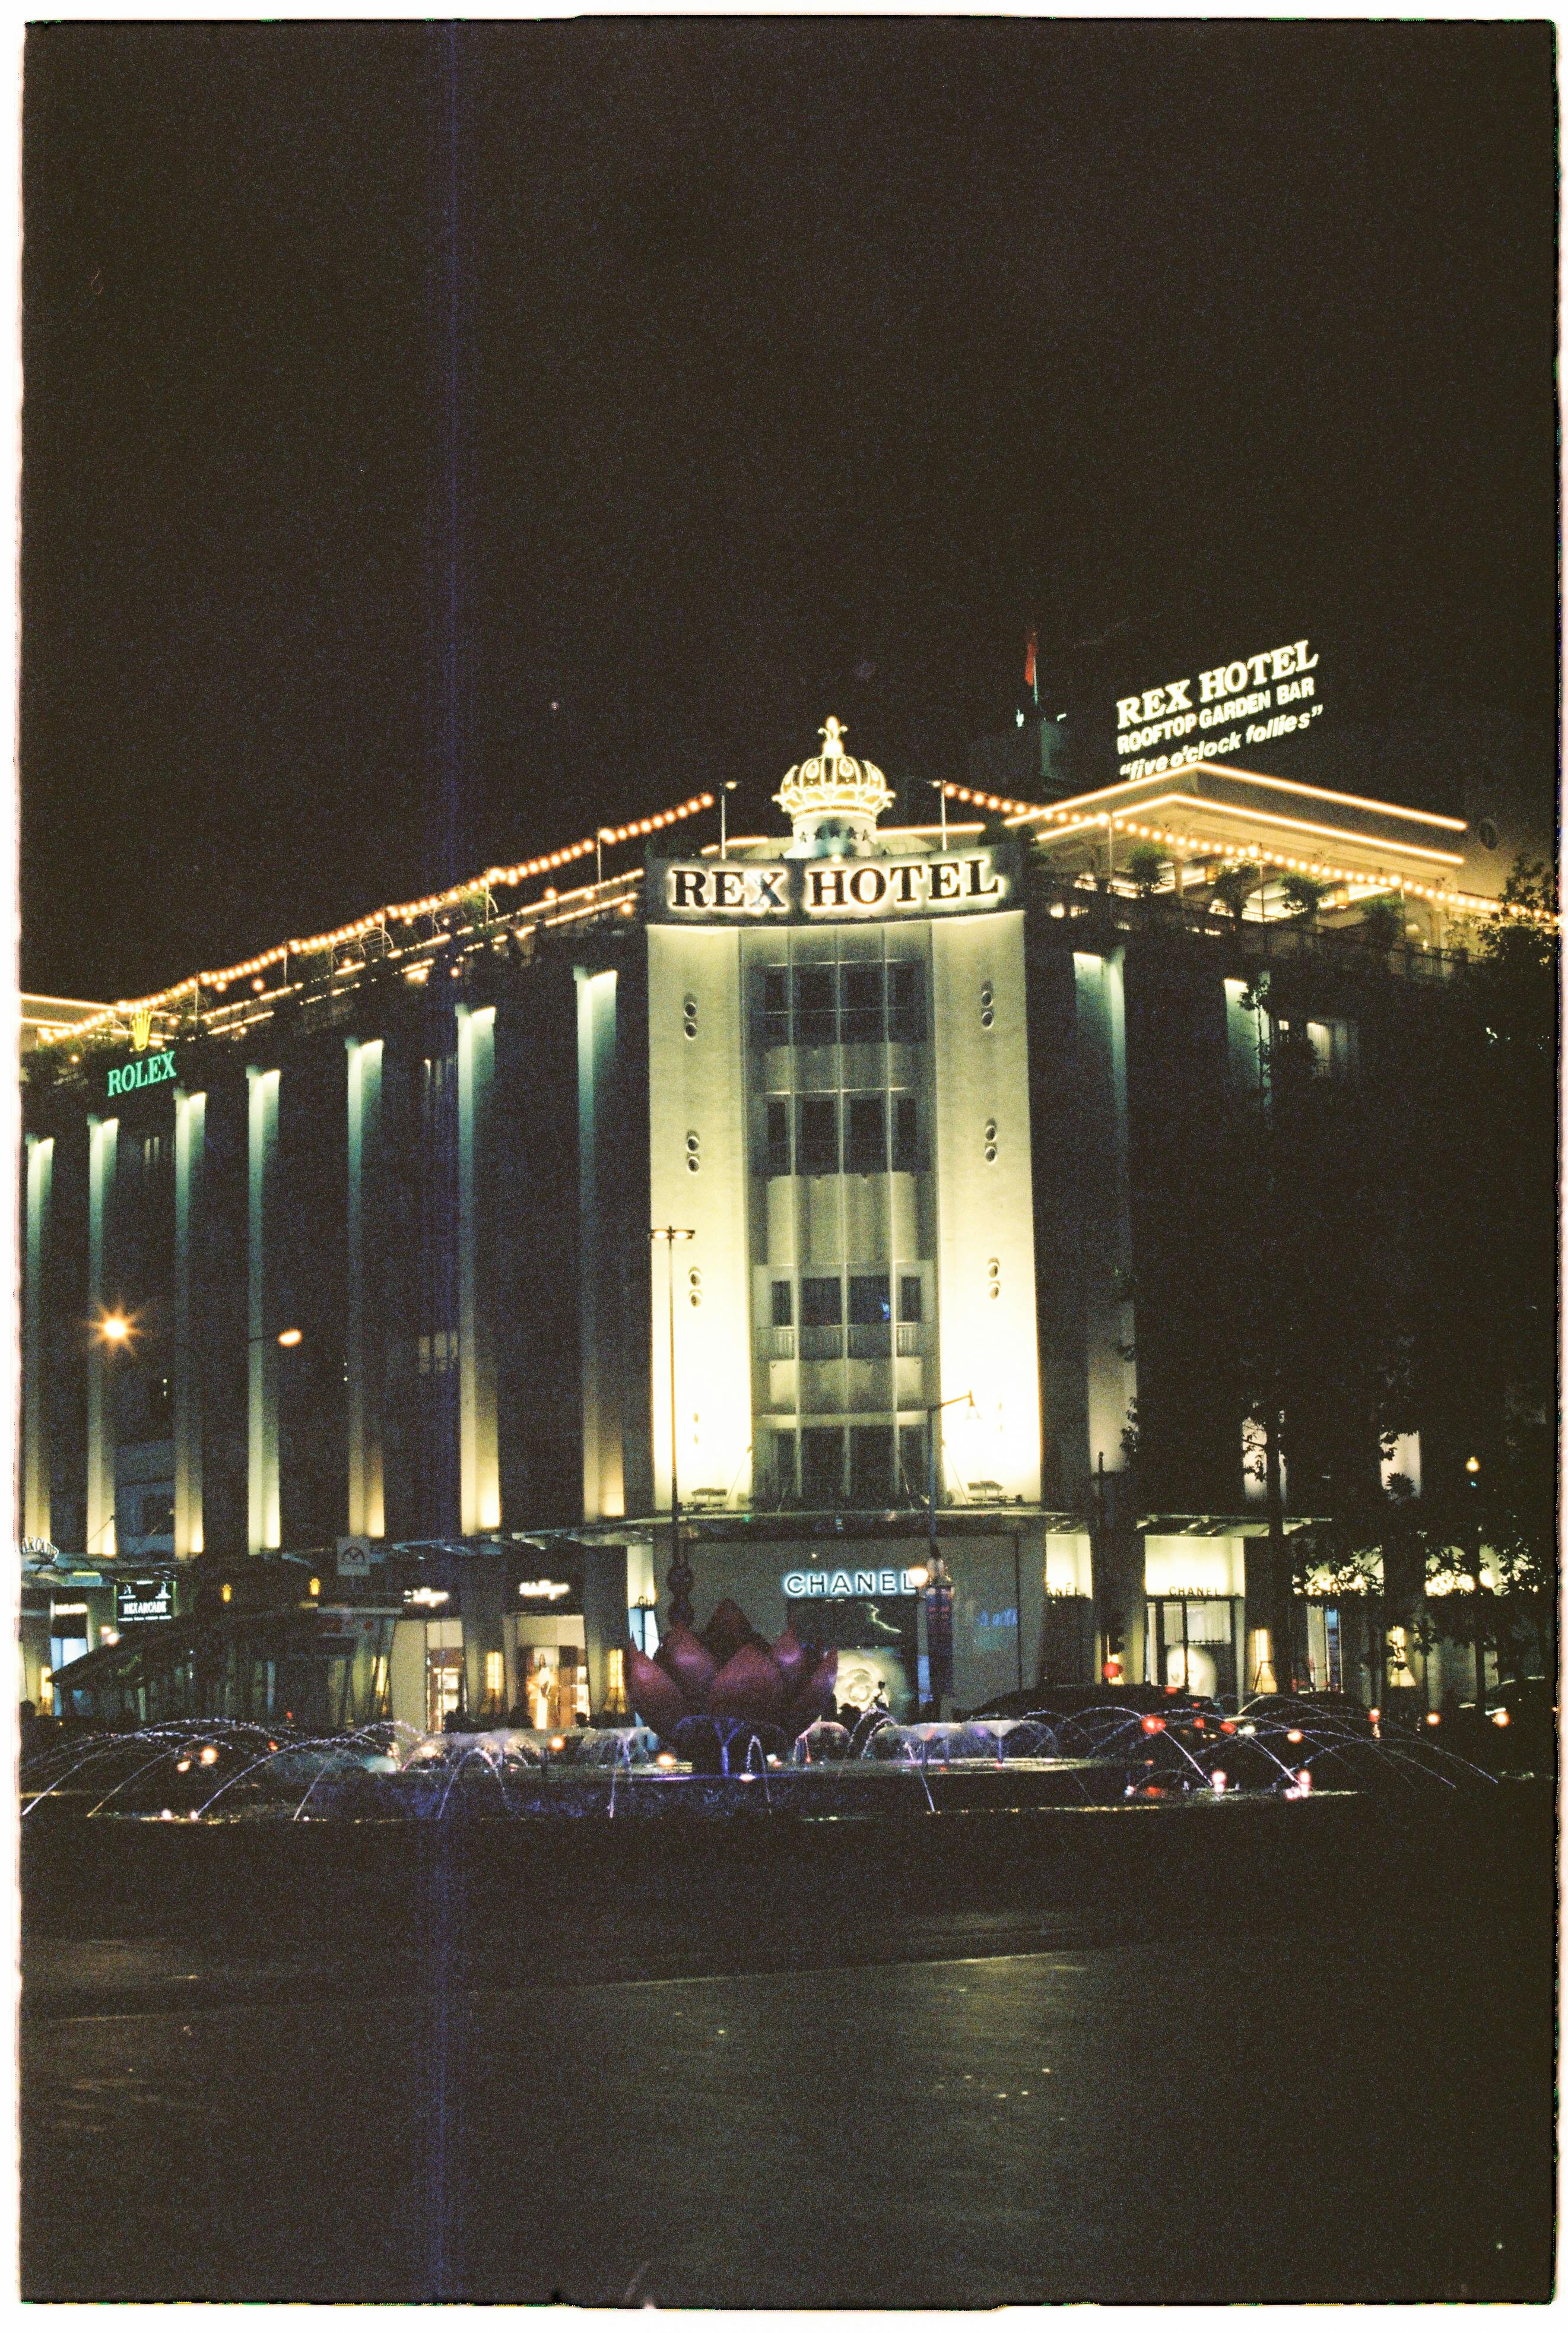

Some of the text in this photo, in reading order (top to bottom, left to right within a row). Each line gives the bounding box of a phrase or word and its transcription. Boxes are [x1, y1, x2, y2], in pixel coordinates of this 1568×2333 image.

[1116, 639, 1319, 730] REX HOTEL
[1117, 677, 1315, 755] ROOFTOP GARDEN BAR
[671, 859, 1000, 909] REX HOTEL
[107, 1050, 177, 1097] ROLEX
[785, 1572, 916, 1595] CHANEL
[1168, 1586, 1219, 1596] CHANEL
[123, 1600, 167, 1615] REX ARCADE
